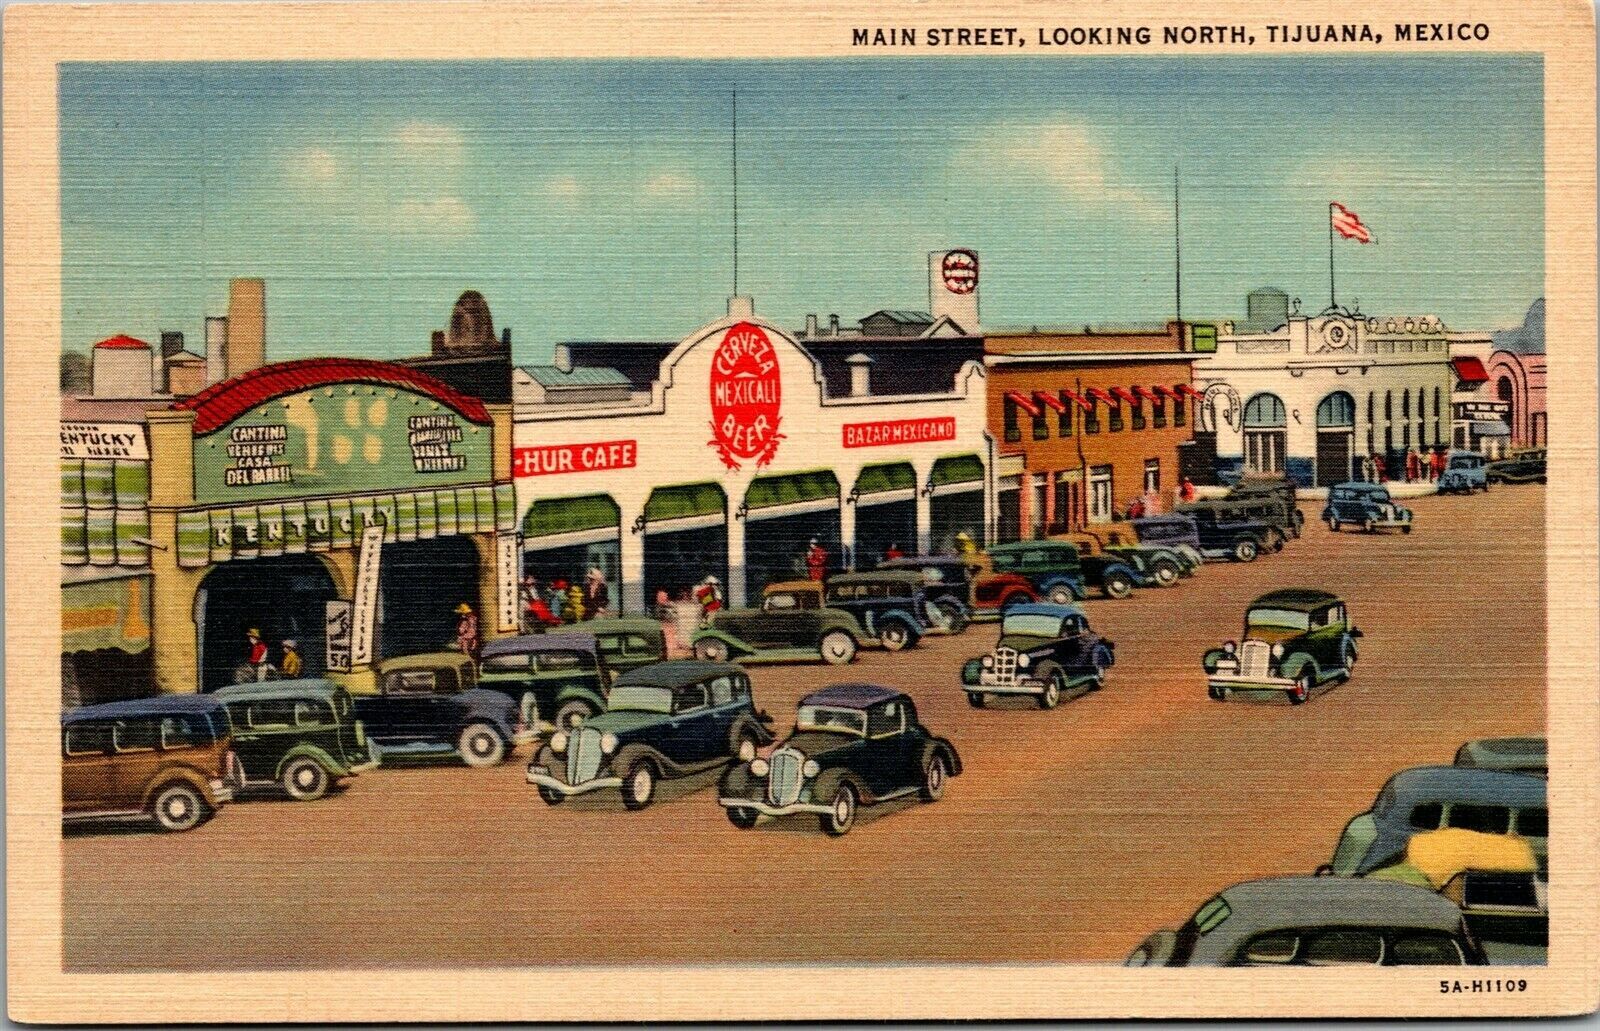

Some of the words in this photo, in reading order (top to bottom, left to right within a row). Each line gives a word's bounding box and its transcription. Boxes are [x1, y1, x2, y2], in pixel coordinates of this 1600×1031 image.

[716, 331, 775, 375] CERVEZA
[715, 379, 777, 407] MEXICALI
[232, 426, 286, 441] CANTINA
[721, 413, 771, 452] BEER
[847, 425, 890, 445] BAZAR
[893, 421, 954, 441] MEXICANO
[582, 444, 633, 468] CAFE
[217, 506, 394, 547] KENTUCKY
